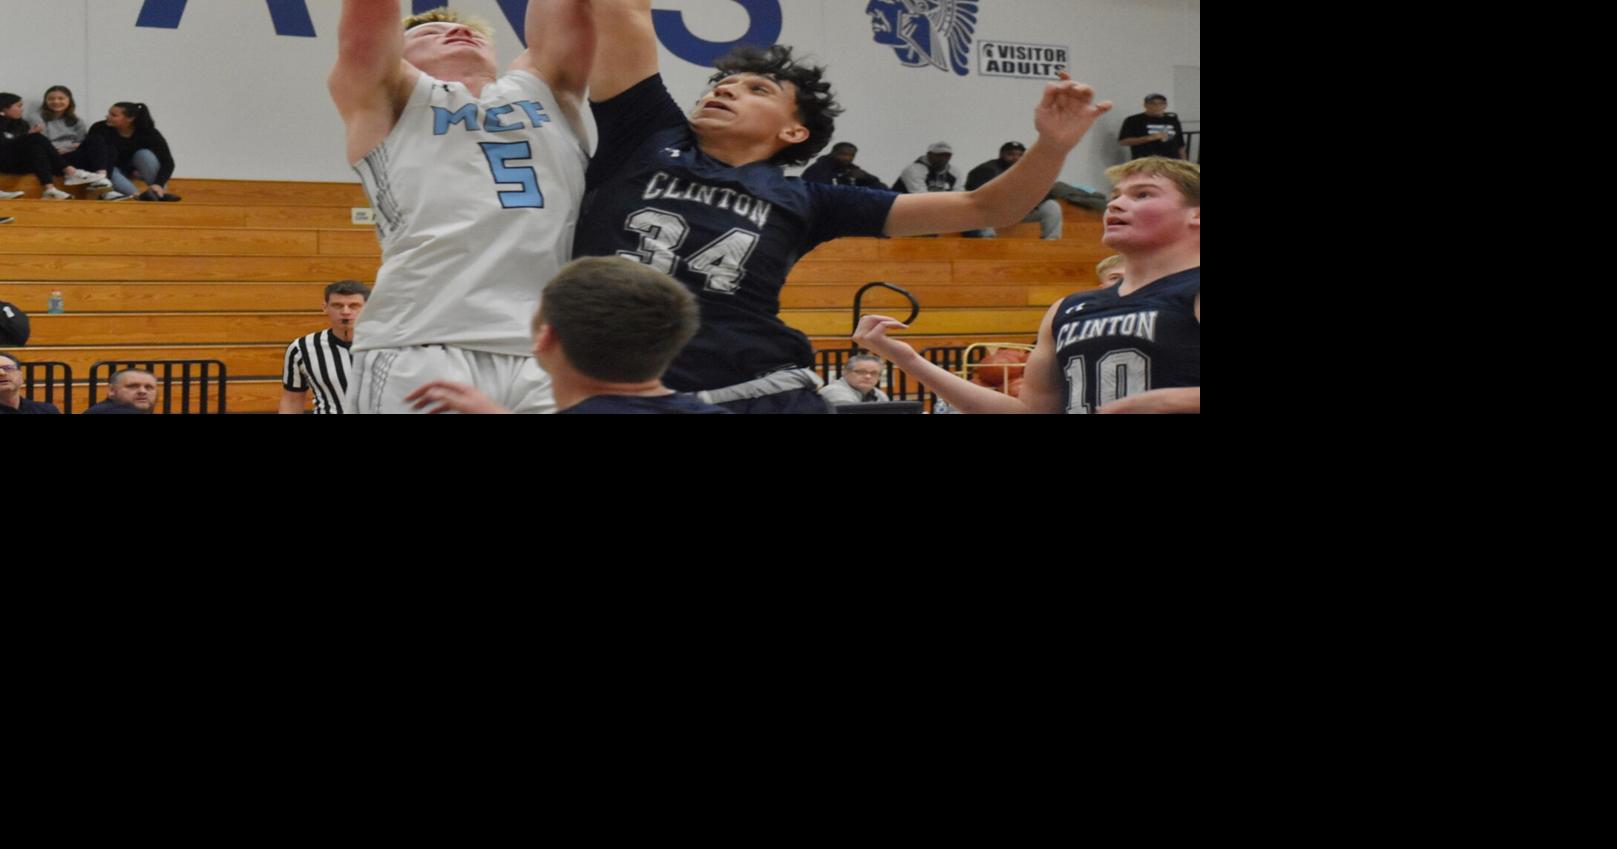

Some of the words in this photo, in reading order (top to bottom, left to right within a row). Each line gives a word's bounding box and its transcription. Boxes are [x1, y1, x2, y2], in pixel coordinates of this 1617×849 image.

[986, 60, 1066, 76] ADULTS
[998, 45, 1066, 62] VISITOR
[477, 140, 544, 209] 5
[642, 171, 771, 229] CLINTON
[615, 206, 760, 295] 34
[1056, 310, 1158, 353] CLINTON
[1064, 347, 1151, 414] 10
